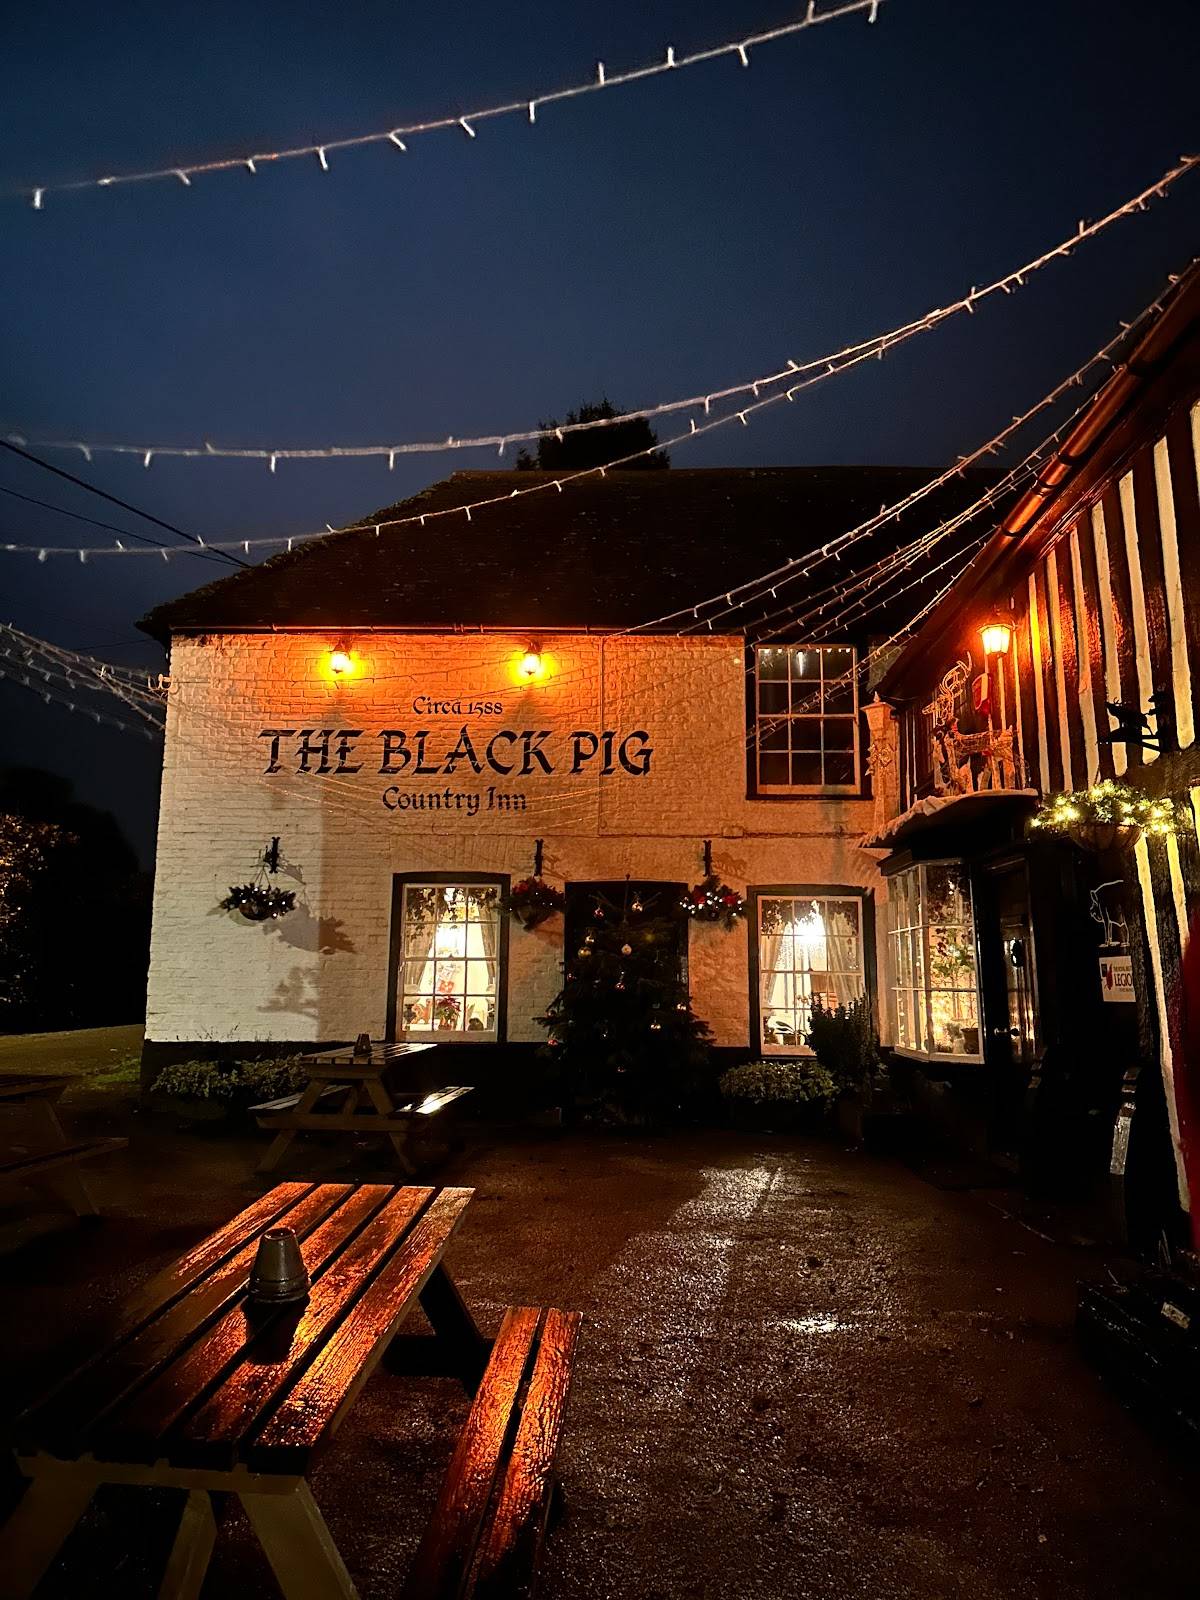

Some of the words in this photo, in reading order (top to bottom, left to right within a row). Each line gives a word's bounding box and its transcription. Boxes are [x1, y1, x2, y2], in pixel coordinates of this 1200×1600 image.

[412, 695, 461, 715] Circa
[468, 702, 504, 720] 1588
[258, 729, 365, 774] THE
[377, 723, 556, 775] BLACK
[567, 729, 653, 776] PIG
[382, 786, 480, 817] Country
[486, 785, 527, 811] Inn
[1114, 973, 1133, 987] LEGIO
